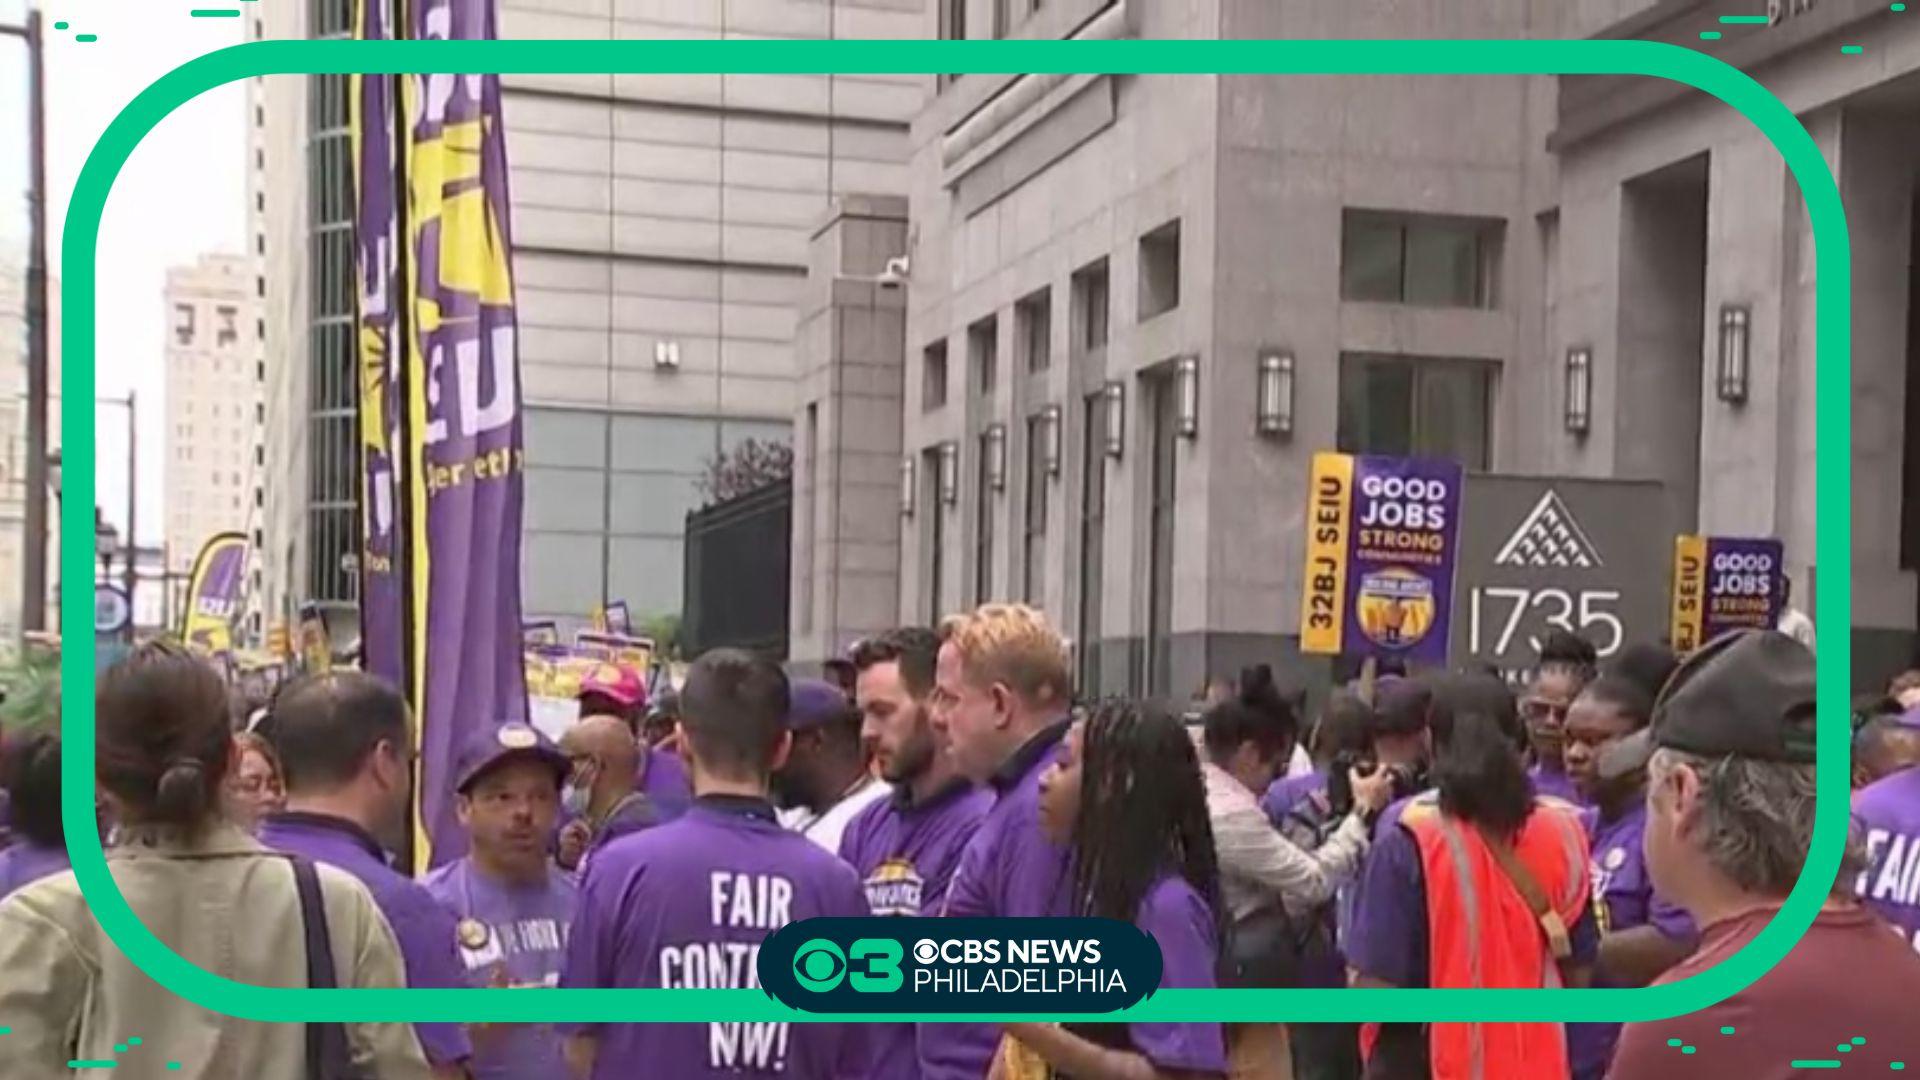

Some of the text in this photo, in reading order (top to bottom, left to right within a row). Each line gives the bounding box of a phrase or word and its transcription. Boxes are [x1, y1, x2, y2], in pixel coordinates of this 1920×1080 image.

[1362, 475, 1447, 501] GOOD
[1361, 500, 1446, 530] JOBS
[1309, 477, 1342, 630] 32BJ SEIU
[1359, 529, 1444, 551] STRONG
[1713, 552, 1772, 572] GOOD
[1678, 556, 1700, 612] SEIU
[1712, 574, 1771, 595] JOBS
[1469, 587, 1623, 657] 1735
[711, 870, 793, 929] FAIR
